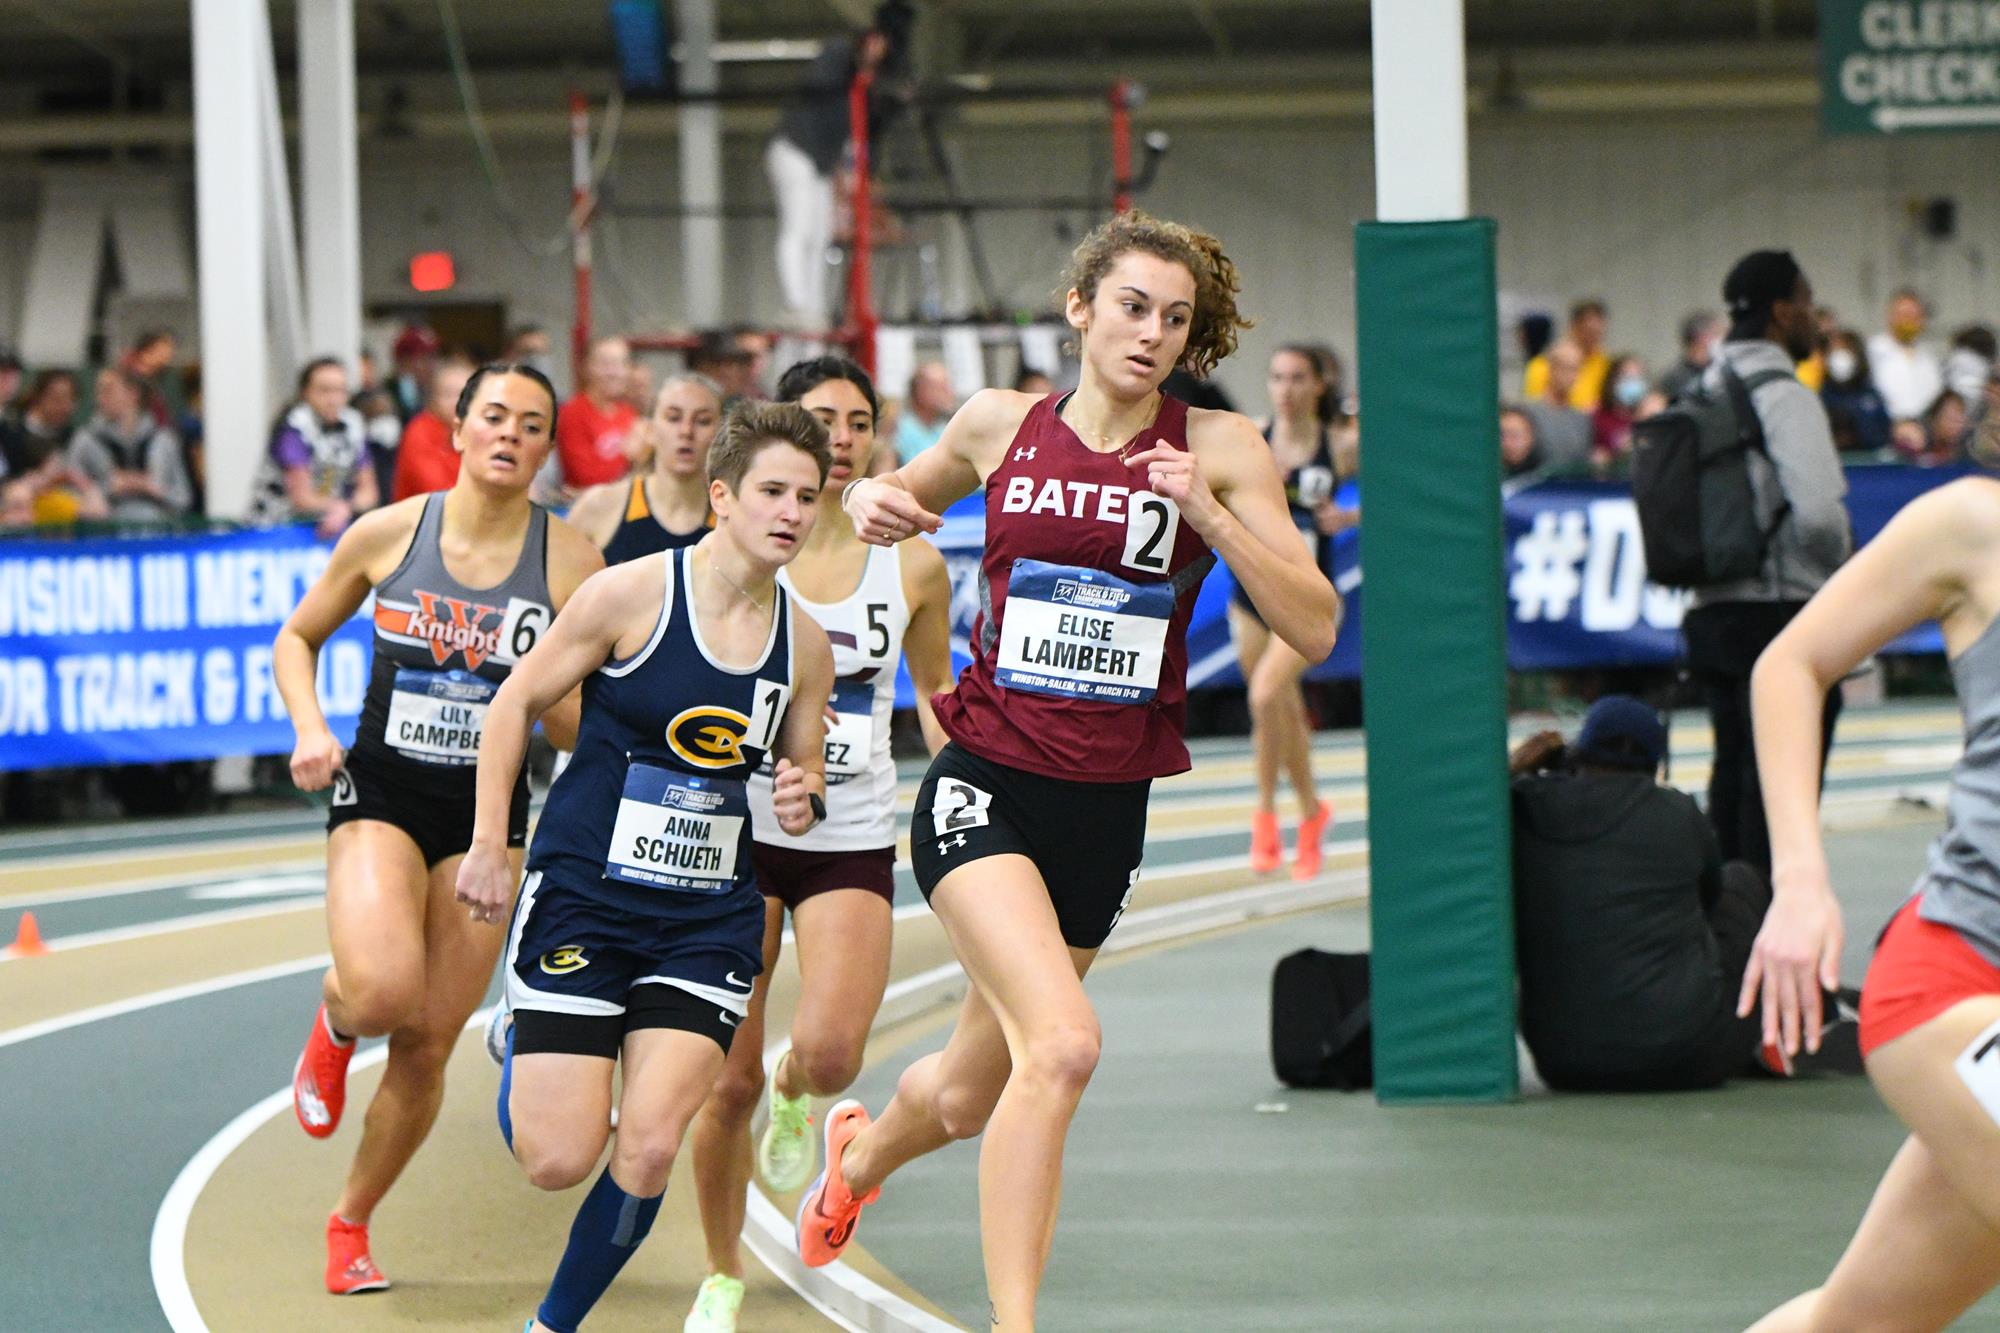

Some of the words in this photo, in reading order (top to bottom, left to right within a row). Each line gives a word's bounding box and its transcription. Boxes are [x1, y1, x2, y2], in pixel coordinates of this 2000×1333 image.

[1002, 476, 1136, 524] BATE
[1133, 500, 1169, 569] 2
[1509, 498, 1697, 632] #D
[139, 552, 189, 631] III
[512, 607, 542, 658] 6
[867, 603, 889, 658] 5
[1057, 613, 1115, 642] ELISE
[1021, 636, 1140, 678] LAMBERT
[53, 647, 198, 734] TRACK
[201, 646, 239, 726] &
[243, 637, 369, 723] FILD
[1010, 672, 1076, 693] WINSTON-SALEM,
[1077, 683, 1089, 694] NC
[1094, 685, 1121, 697] MARCH
[440, 705, 472, 726] LILY
[764, 688, 781, 746] 1
[825, 742, 850, 766] EZ
[663, 816, 711, 841] ANNA
[945, 784, 977, 831] 2
[632, 836, 722, 871] SCHUETH
